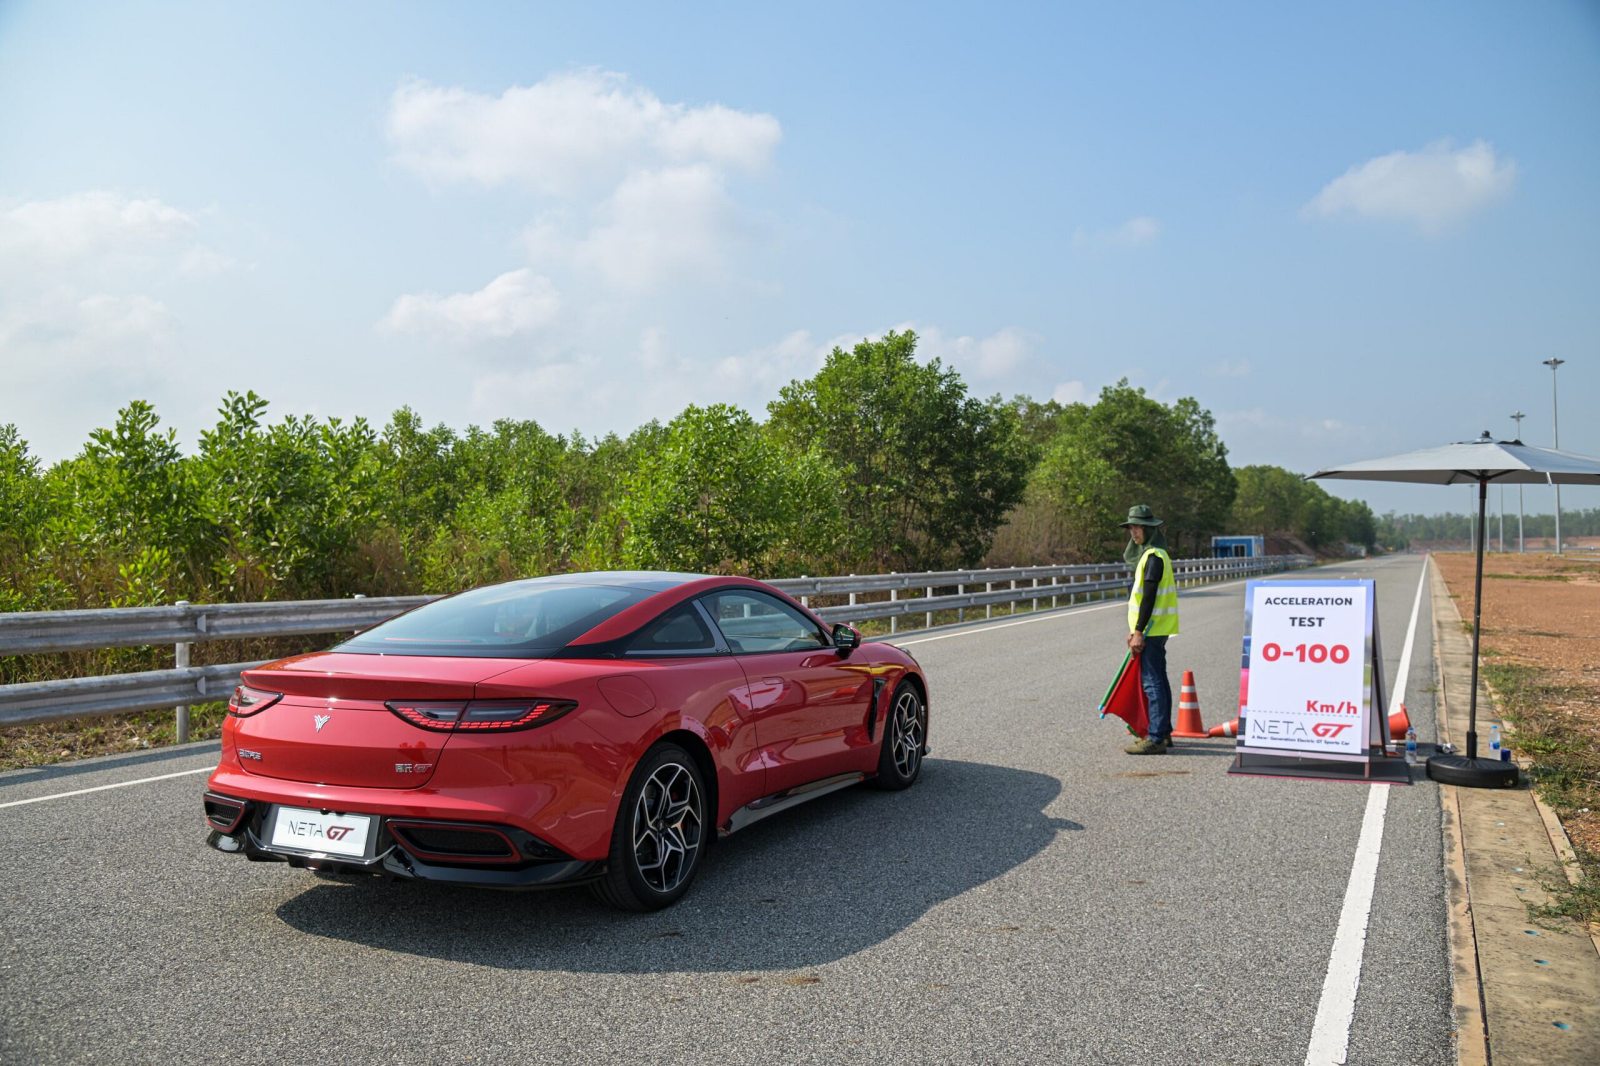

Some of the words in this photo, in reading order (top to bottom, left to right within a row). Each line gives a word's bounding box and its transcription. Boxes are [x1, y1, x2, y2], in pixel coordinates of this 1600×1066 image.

[1264, 597, 1353, 606] ACCELERATION
[1289, 616, 1325, 628] TEST
[1262, 642, 1350, 664] 0-100
[1306, 700, 1358, 715] Km/h
[1253, 719, 1308, 736] NETA
[1312, 722, 1354, 738] GT
[288, 820, 324, 838] NETA
[326, 825, 355, 841] GT
